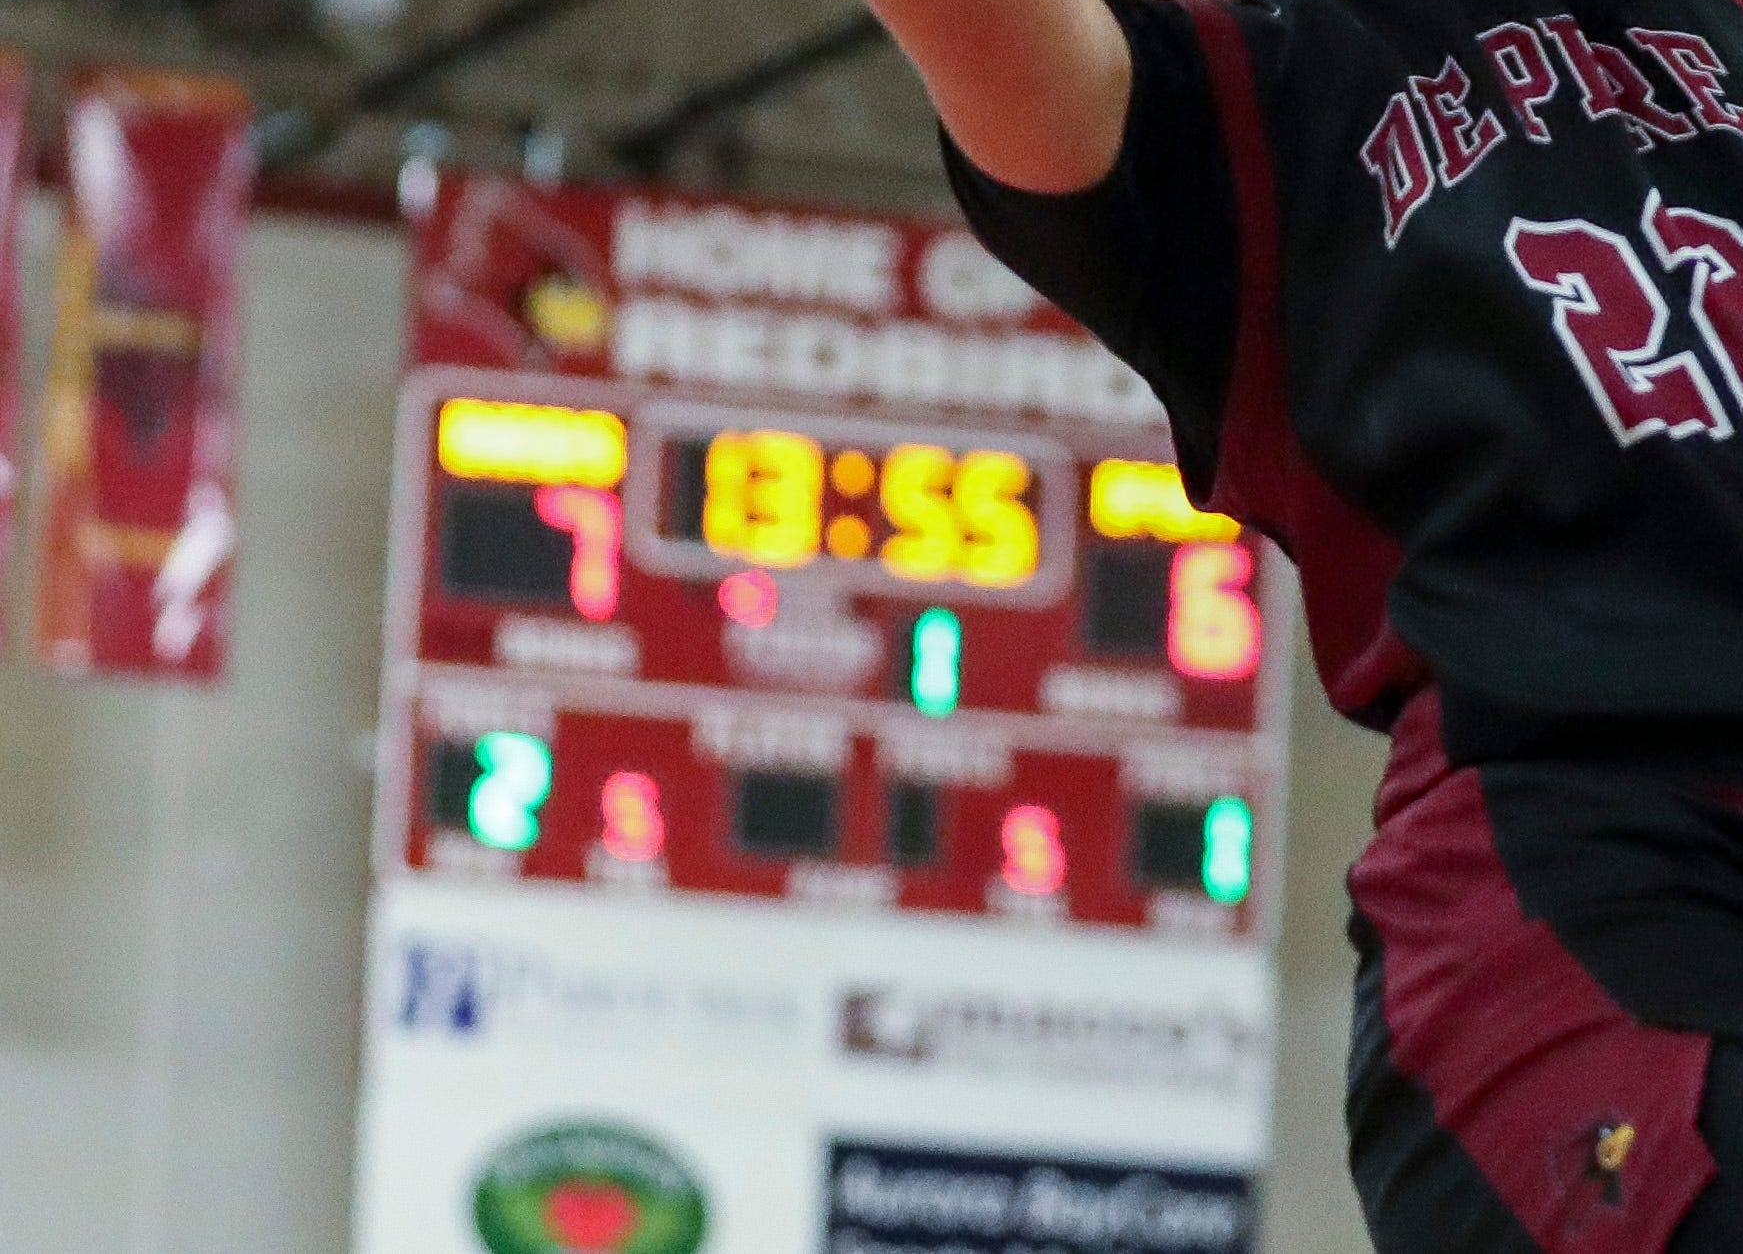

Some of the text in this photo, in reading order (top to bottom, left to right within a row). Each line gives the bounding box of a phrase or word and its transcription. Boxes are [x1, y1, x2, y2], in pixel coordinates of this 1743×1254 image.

[1359, 54, 1508, 250] DE
[535, 484, 622, 621] 7
[703, 429, 1039, 589] 13:55
[1166, 541, 1263, 680] 6
[468, 730, 553, 851] 2
